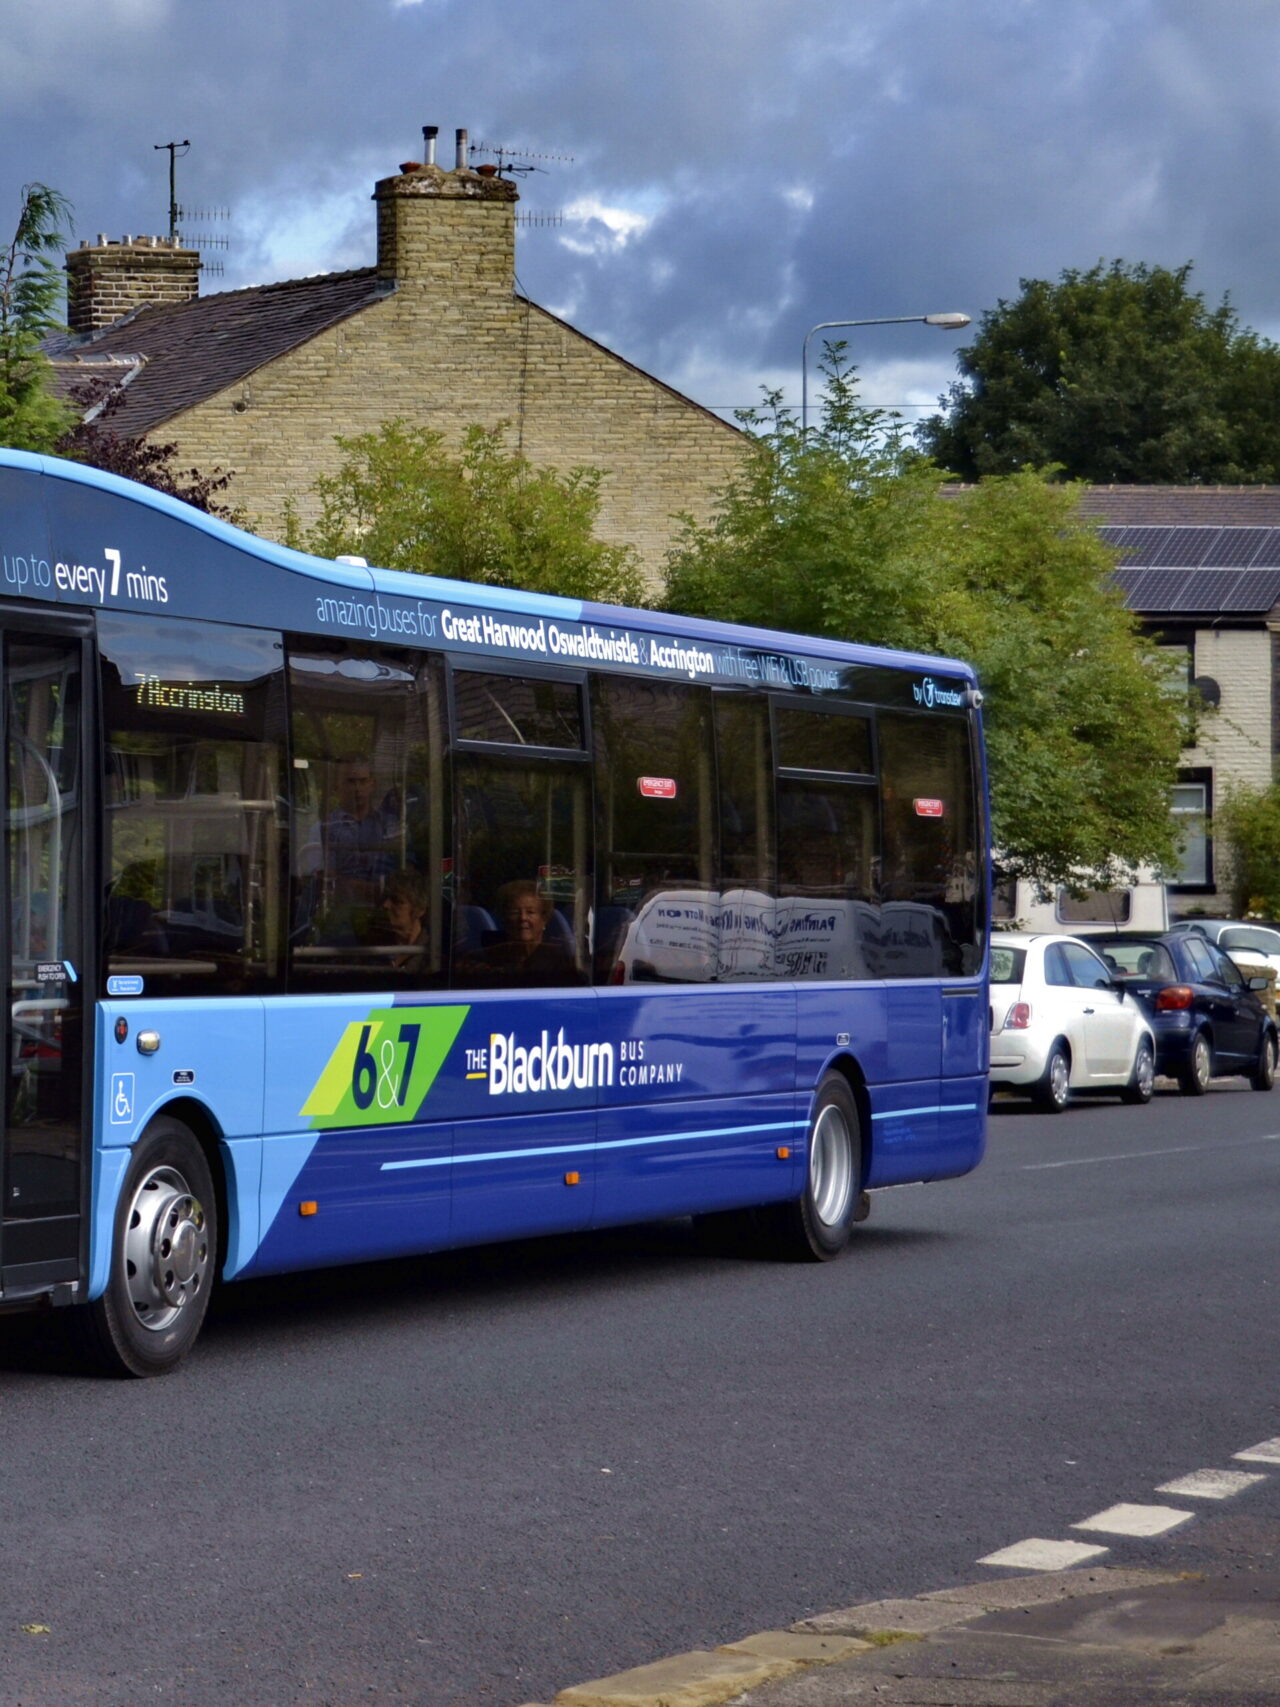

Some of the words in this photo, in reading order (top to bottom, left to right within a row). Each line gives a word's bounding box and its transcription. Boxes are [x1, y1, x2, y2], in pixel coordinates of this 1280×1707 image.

[3, 554, 29, 593] up
[30, 553, 51, 588] to
[54, 562, 105, 604] every
[104, 548, 121, 596] 7
[126, 565, 169, 603] mins
[316, 595, 378, 638] amazing
[376, 595, 418, 635] buses
[417, 601, 438, 637] for
[441, 608, 482, 645] Great
[548, 624, 640, 665] Oswaldtwistle
[639, 637, 650, 666] &
[650, 639, 715, 679] Accrington
[715, 650, 737, 678] with
[736, 648, 759, 681] free
[779, 656, 789, 684] &
[787, 658, 808, 687] USB
[808, 666, 839, 695] power
[134, 673, 146, 704] 7
[912, 682, 922, 705] by
[465, 1048, 488, 1071] THE
[489, 1025, 614, 1096] Blackburn
[620, 1040, 645, 1062] BUS
[619, 1062, 683, 1087] COMPANY
